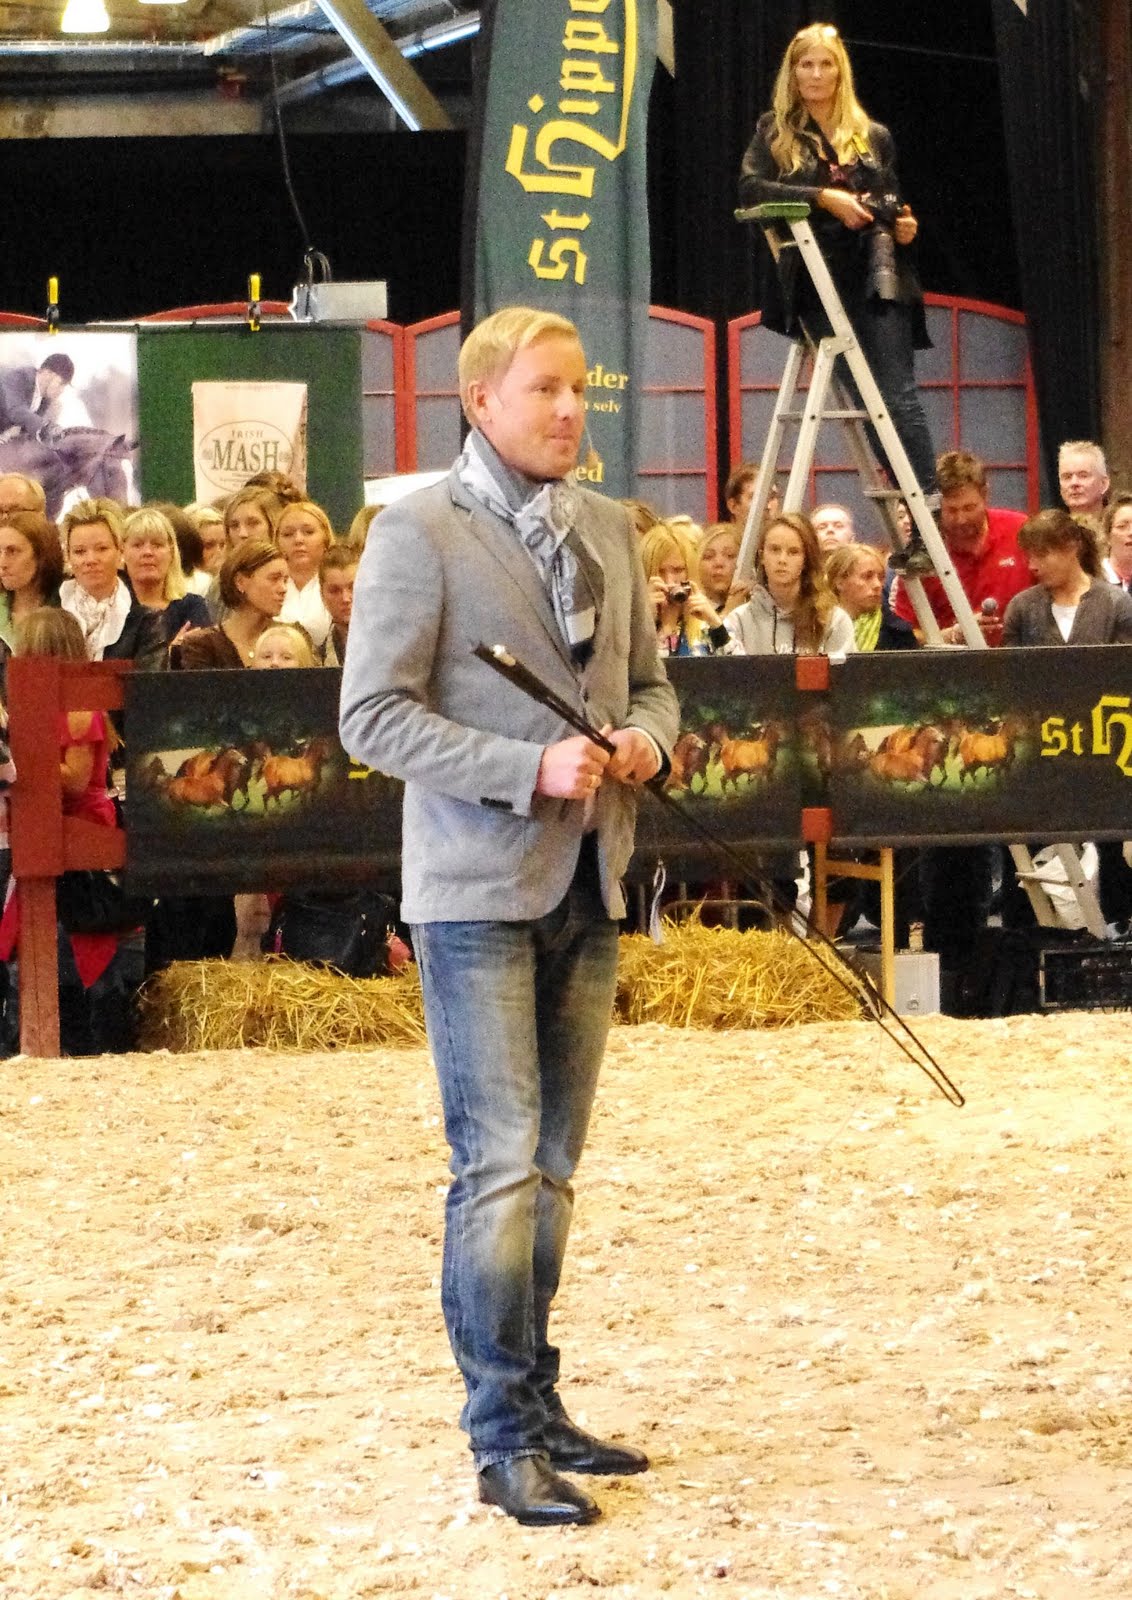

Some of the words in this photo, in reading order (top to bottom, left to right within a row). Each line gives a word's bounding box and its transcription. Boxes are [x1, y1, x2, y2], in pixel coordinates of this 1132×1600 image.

[528, 209, 592, 285] St
[231, 430, 264, 438] IRISH
[211, 440, 280, 472] MASH
[1041, 717, 1084, 756] St
